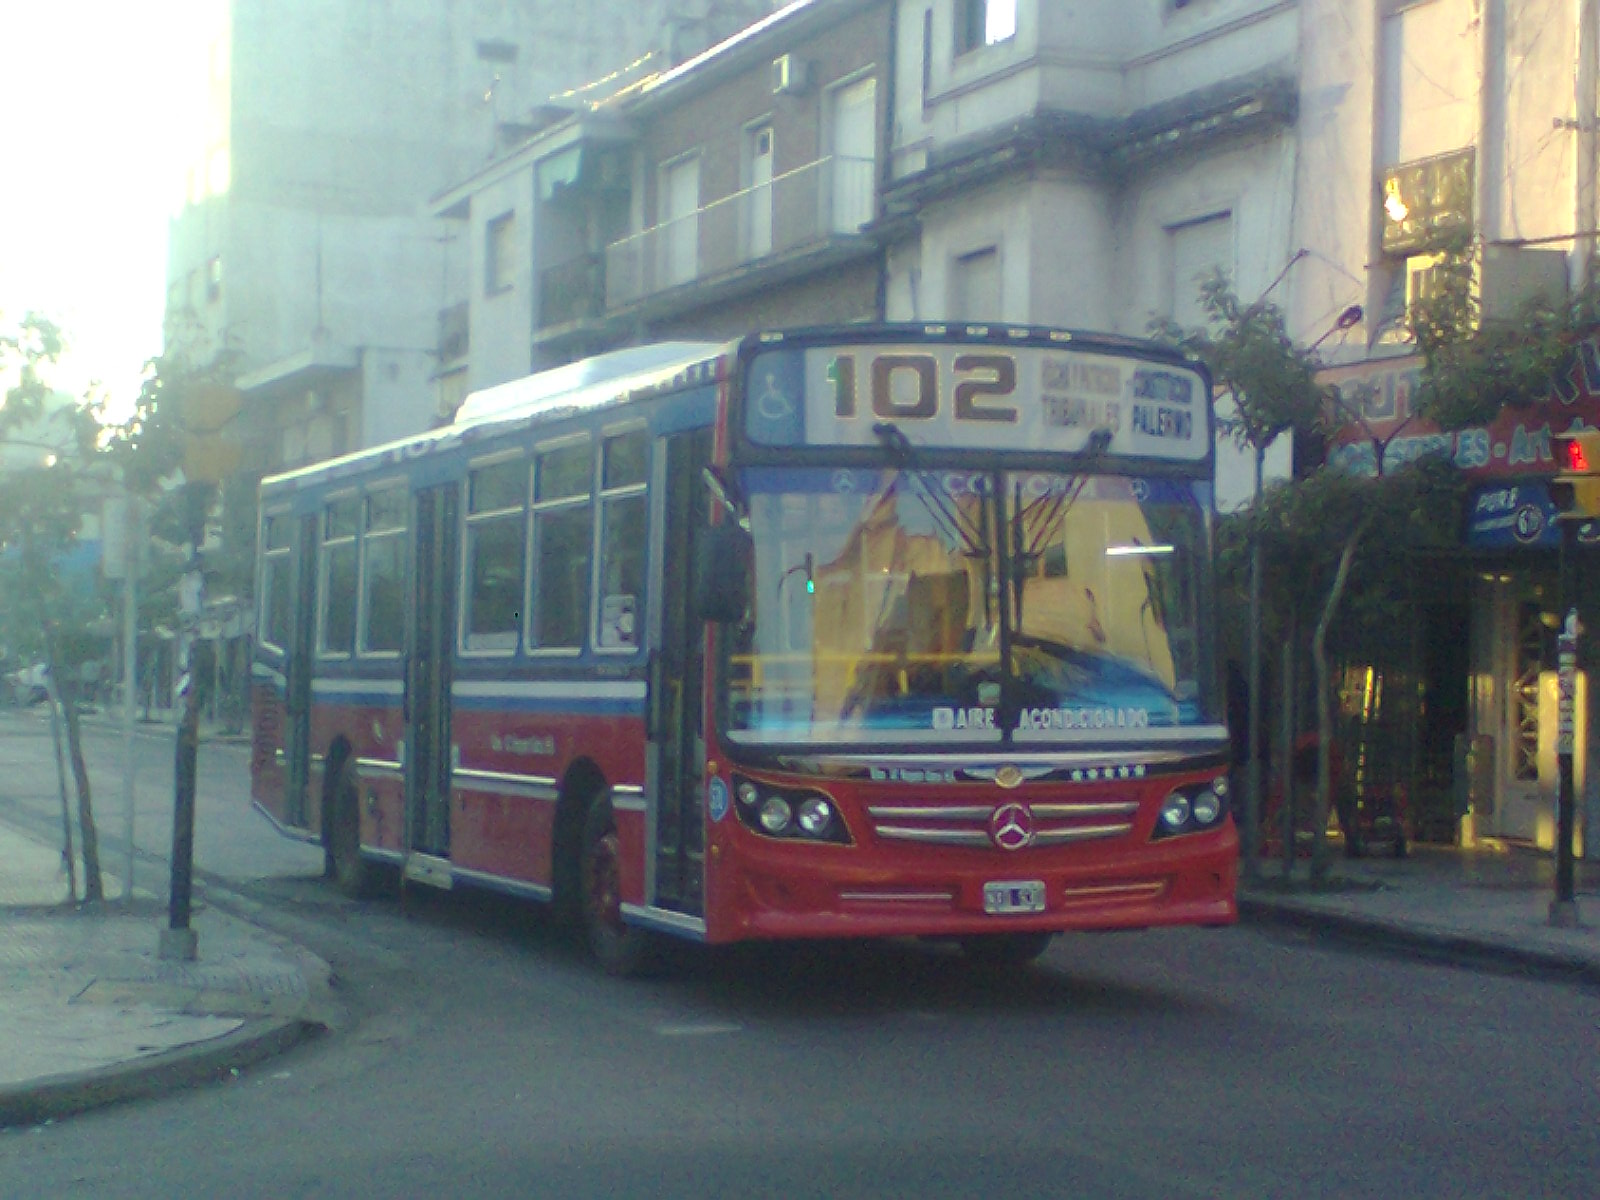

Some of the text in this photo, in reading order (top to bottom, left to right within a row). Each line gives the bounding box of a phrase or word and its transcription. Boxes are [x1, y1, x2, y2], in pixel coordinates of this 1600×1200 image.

[827, 353, 1018, 422] 102
[1133, 404, 1192, 440] PALERMO
[956, 708, 995, 729] AIRE
